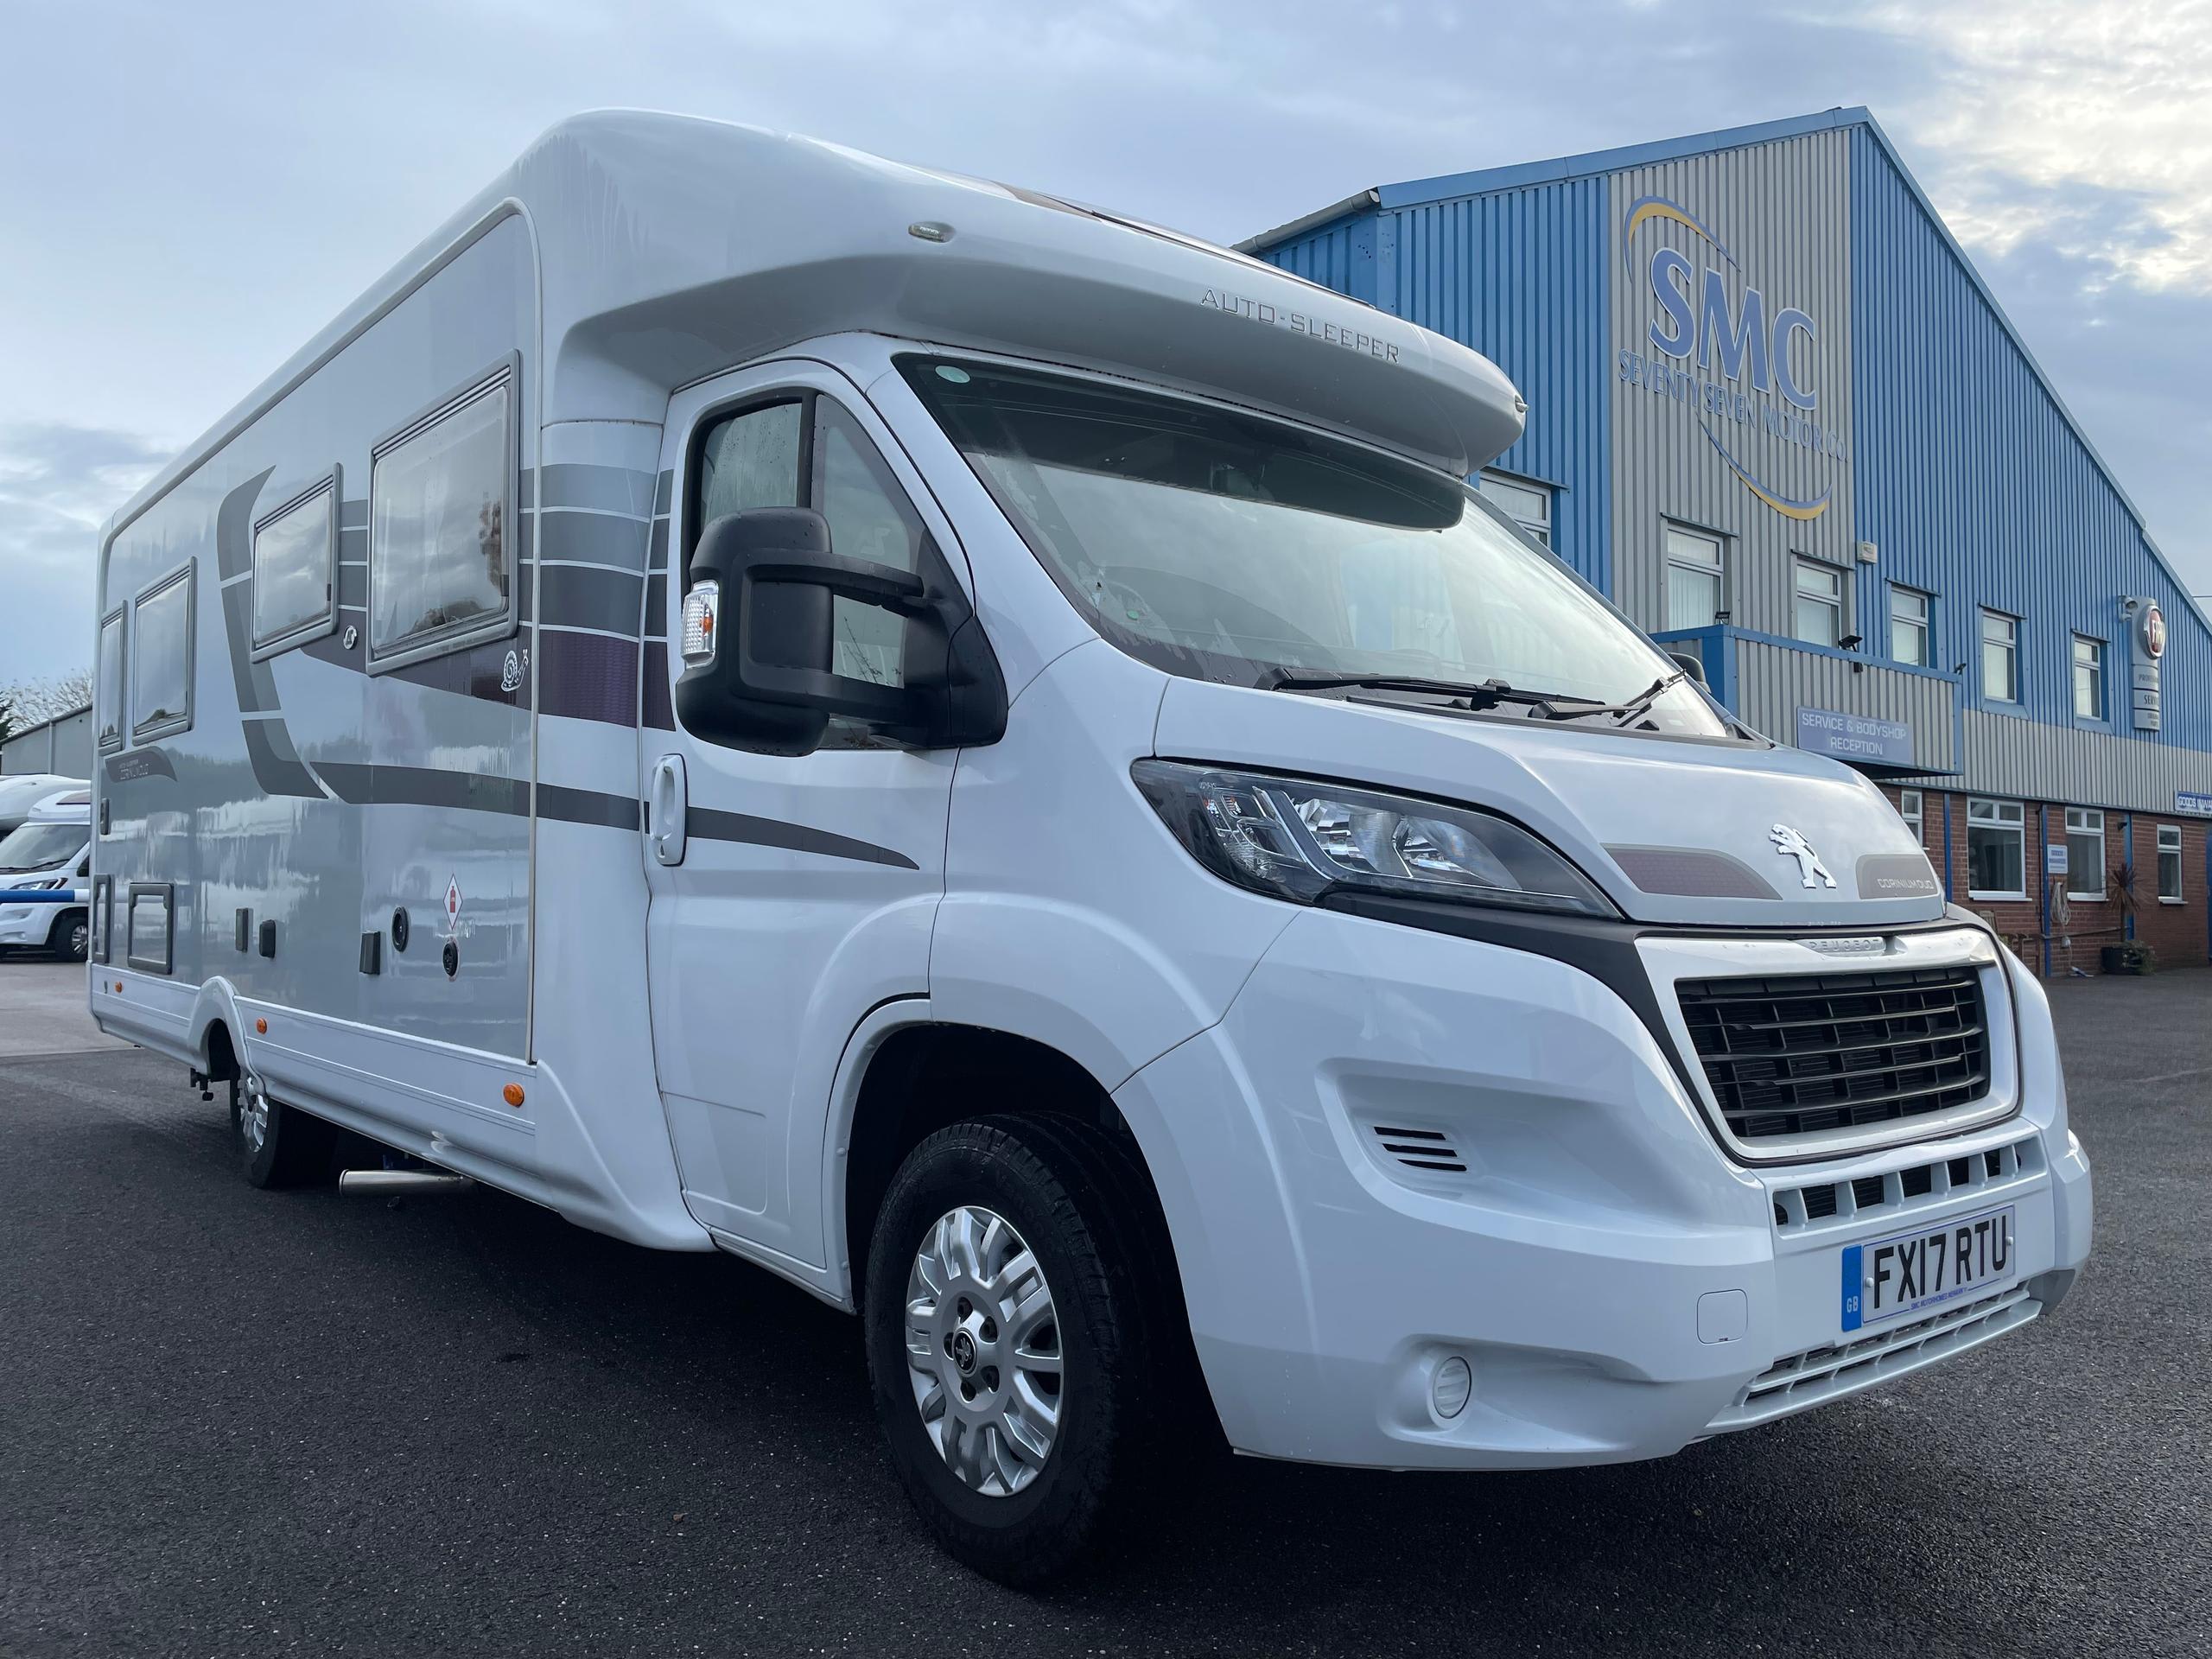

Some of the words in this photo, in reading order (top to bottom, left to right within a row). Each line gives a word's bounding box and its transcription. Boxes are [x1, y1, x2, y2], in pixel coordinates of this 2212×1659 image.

[1200, 288, 1400, 364] AUTO-SLEEPER
[1649, 247, 1817, 410] SMC
[1618, 347, 1701, 407] SEVENTY
[1703, 383, 1756, 429] SEVEN
[1763, 404, 1824, 454] MOTOR
[1802, 712, 1843, 731] SERVICE
[1847, 720, 1854, 733] &
[1856, 721, 1906, 740] BODYSHOP
[1830, 736, 1883, 755] RECEPTION
[1808, 938, 1879, 951] PEUGEOT
[1873, 1233, 1947, 1309] FX17
[1955, 1215, 2006, 1286] RTU
[1847, 1295, 1858, 1313] GB
